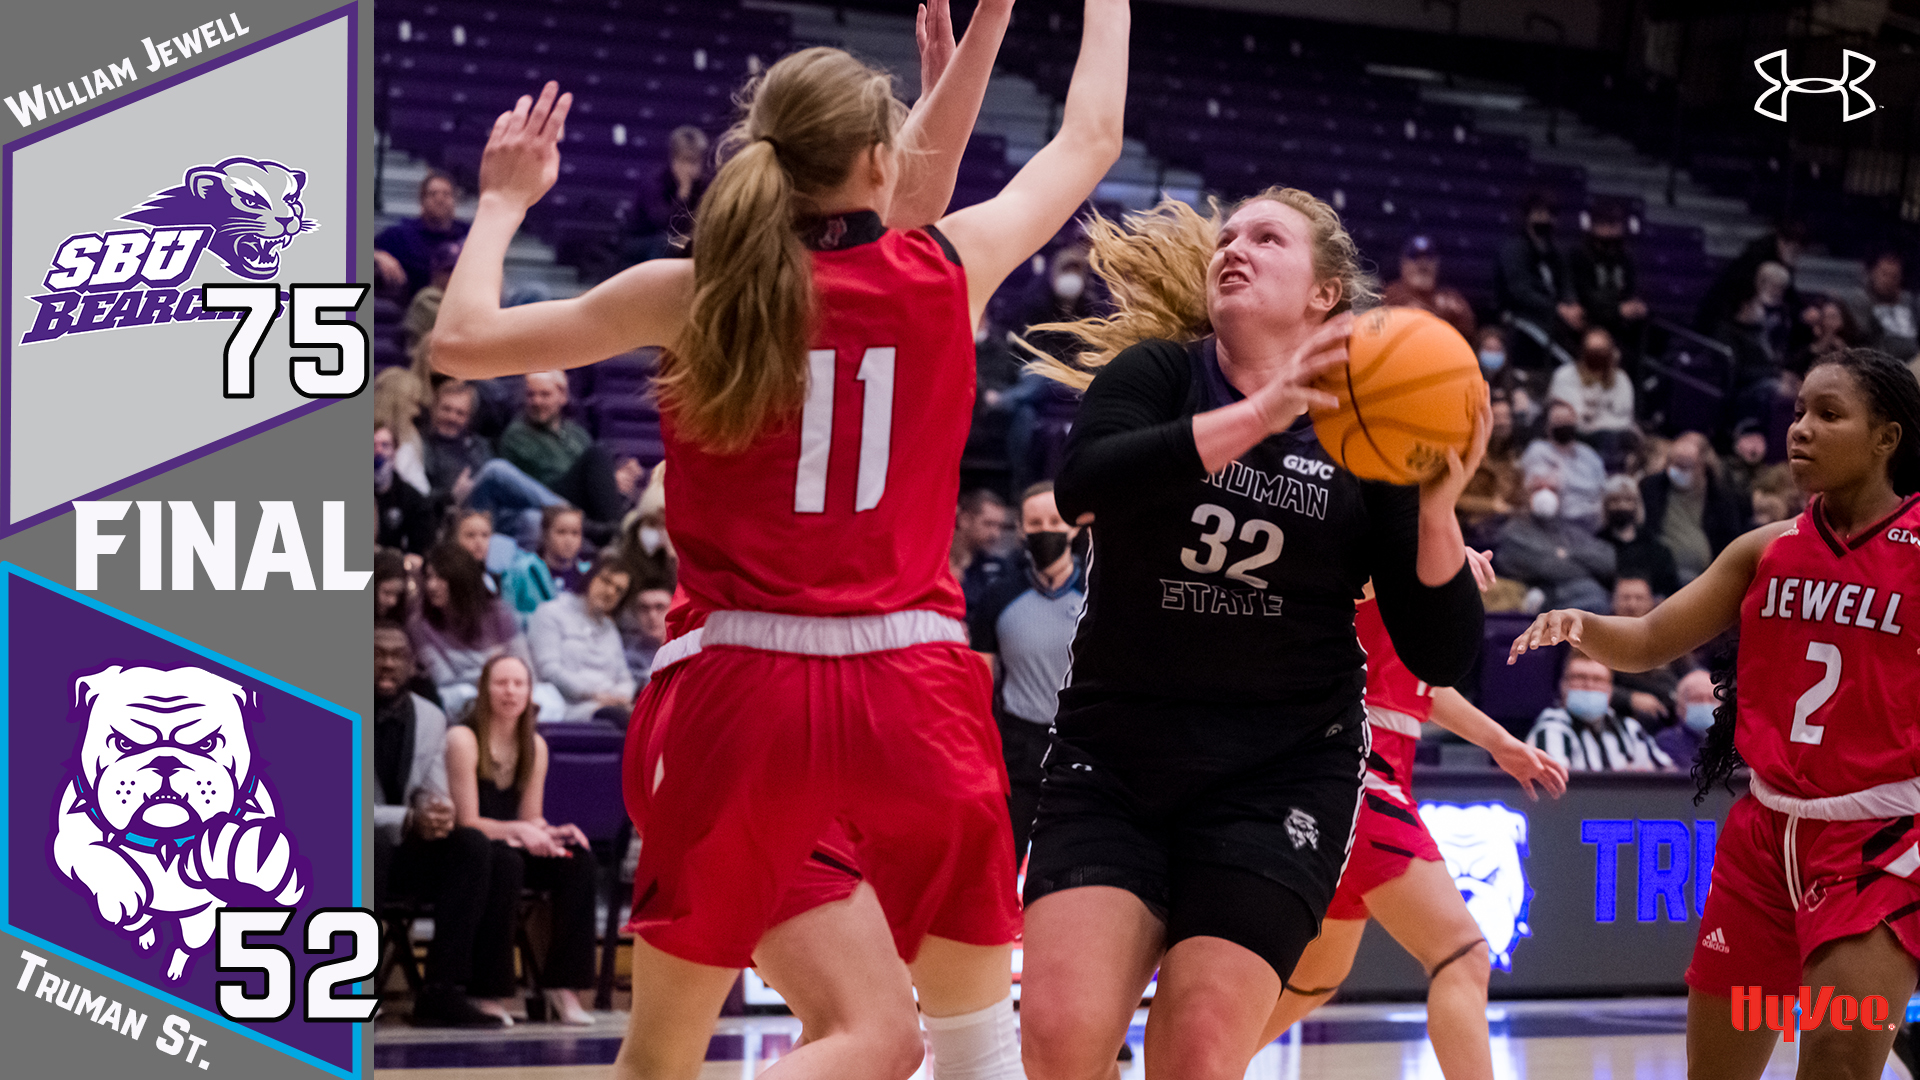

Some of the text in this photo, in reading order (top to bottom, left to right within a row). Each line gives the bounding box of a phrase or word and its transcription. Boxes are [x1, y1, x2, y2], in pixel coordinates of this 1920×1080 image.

[794, 347, 897, 512] 11
[1283, 454, 1335, 480] GLVC
[1180, 503, 1285, 590] 32
[1159, 578, 1284, 616] STATE
[1760, 576, 1902, 636] JEWELL
[1790, 641, 1843, 746] 2
[1702, 938, 1730, 954] adidas
